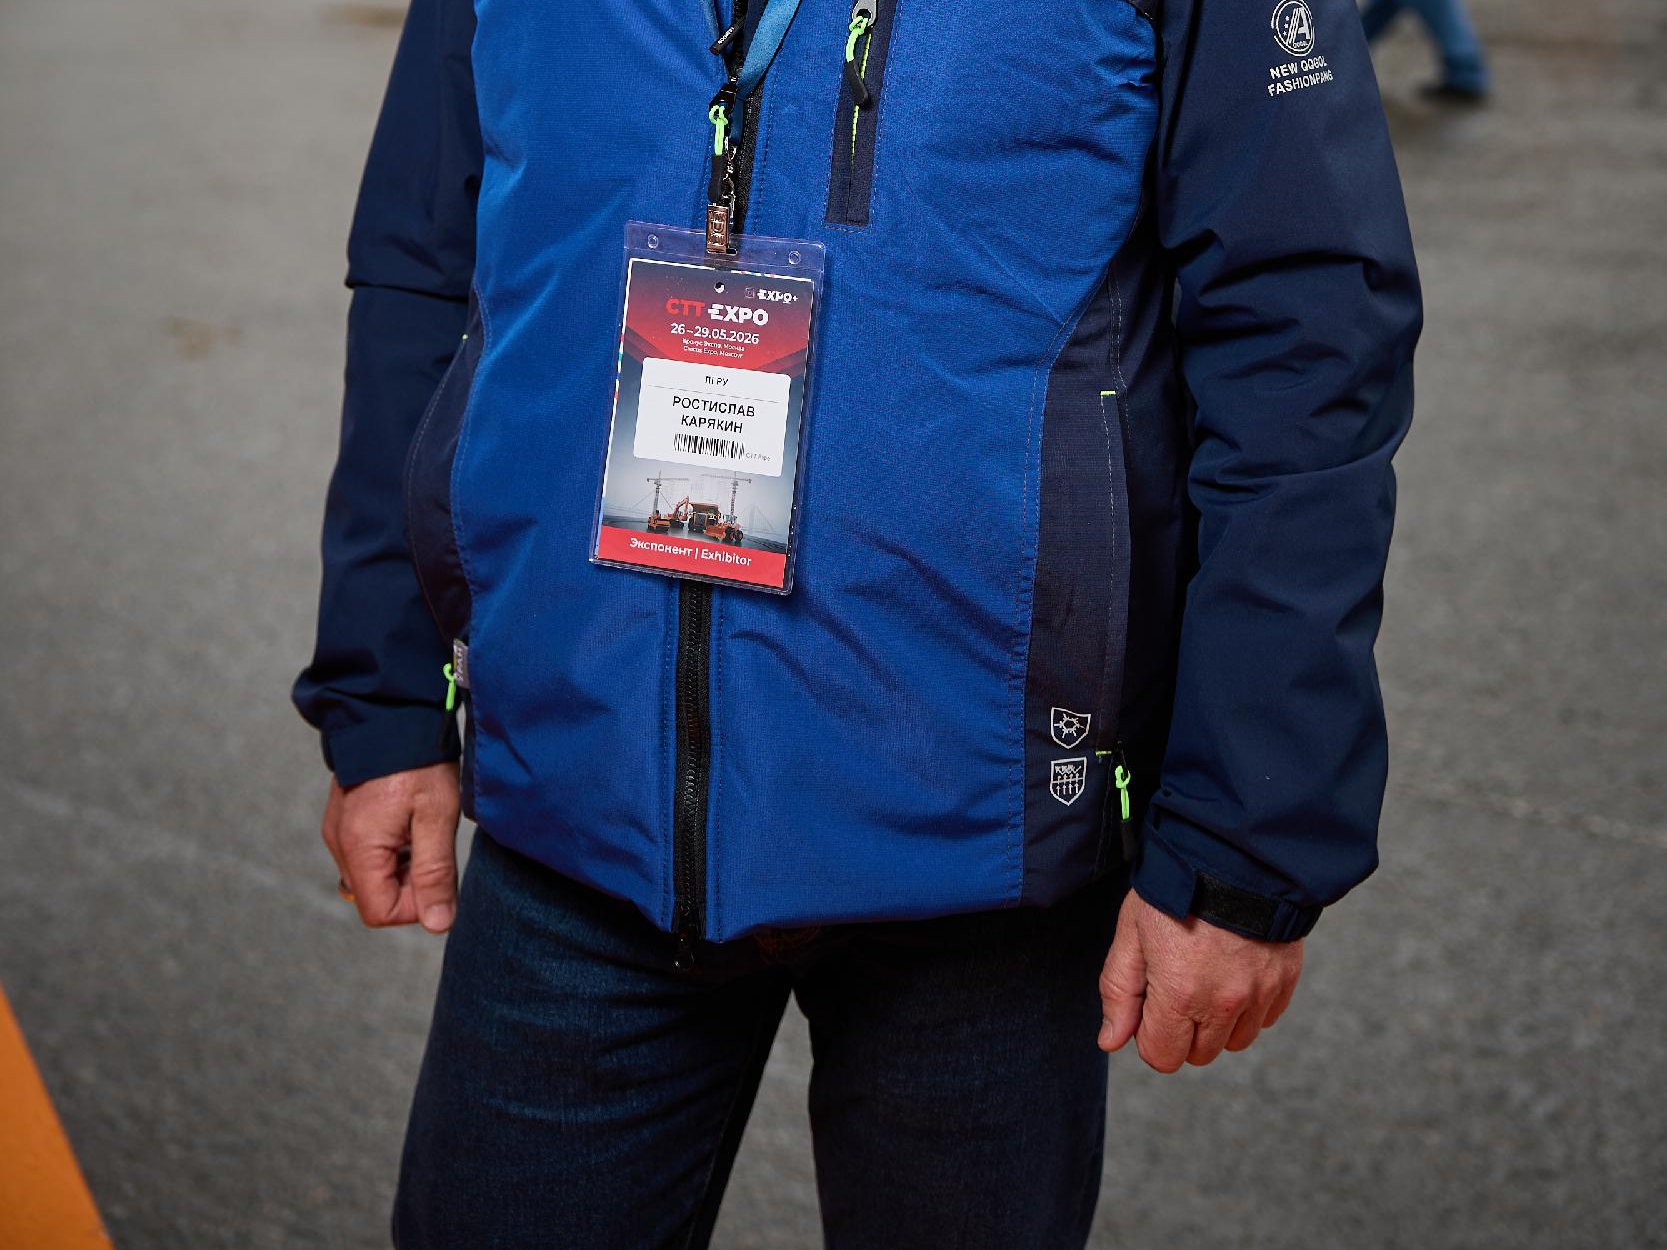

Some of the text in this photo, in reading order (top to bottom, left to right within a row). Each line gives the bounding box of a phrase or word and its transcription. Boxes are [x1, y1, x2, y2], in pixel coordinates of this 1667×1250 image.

[1269, 62, 1298, 79] NEW
[665, 298, 769, 326] CTT EXPO
[672, 395, 755, 418] РОСТИСЛАВ
[681, 414, 743, 434] КАРЯКИН
[629, 537, 693, 557] Экспонент
[700, 548, 752, 567] Exhibitor
